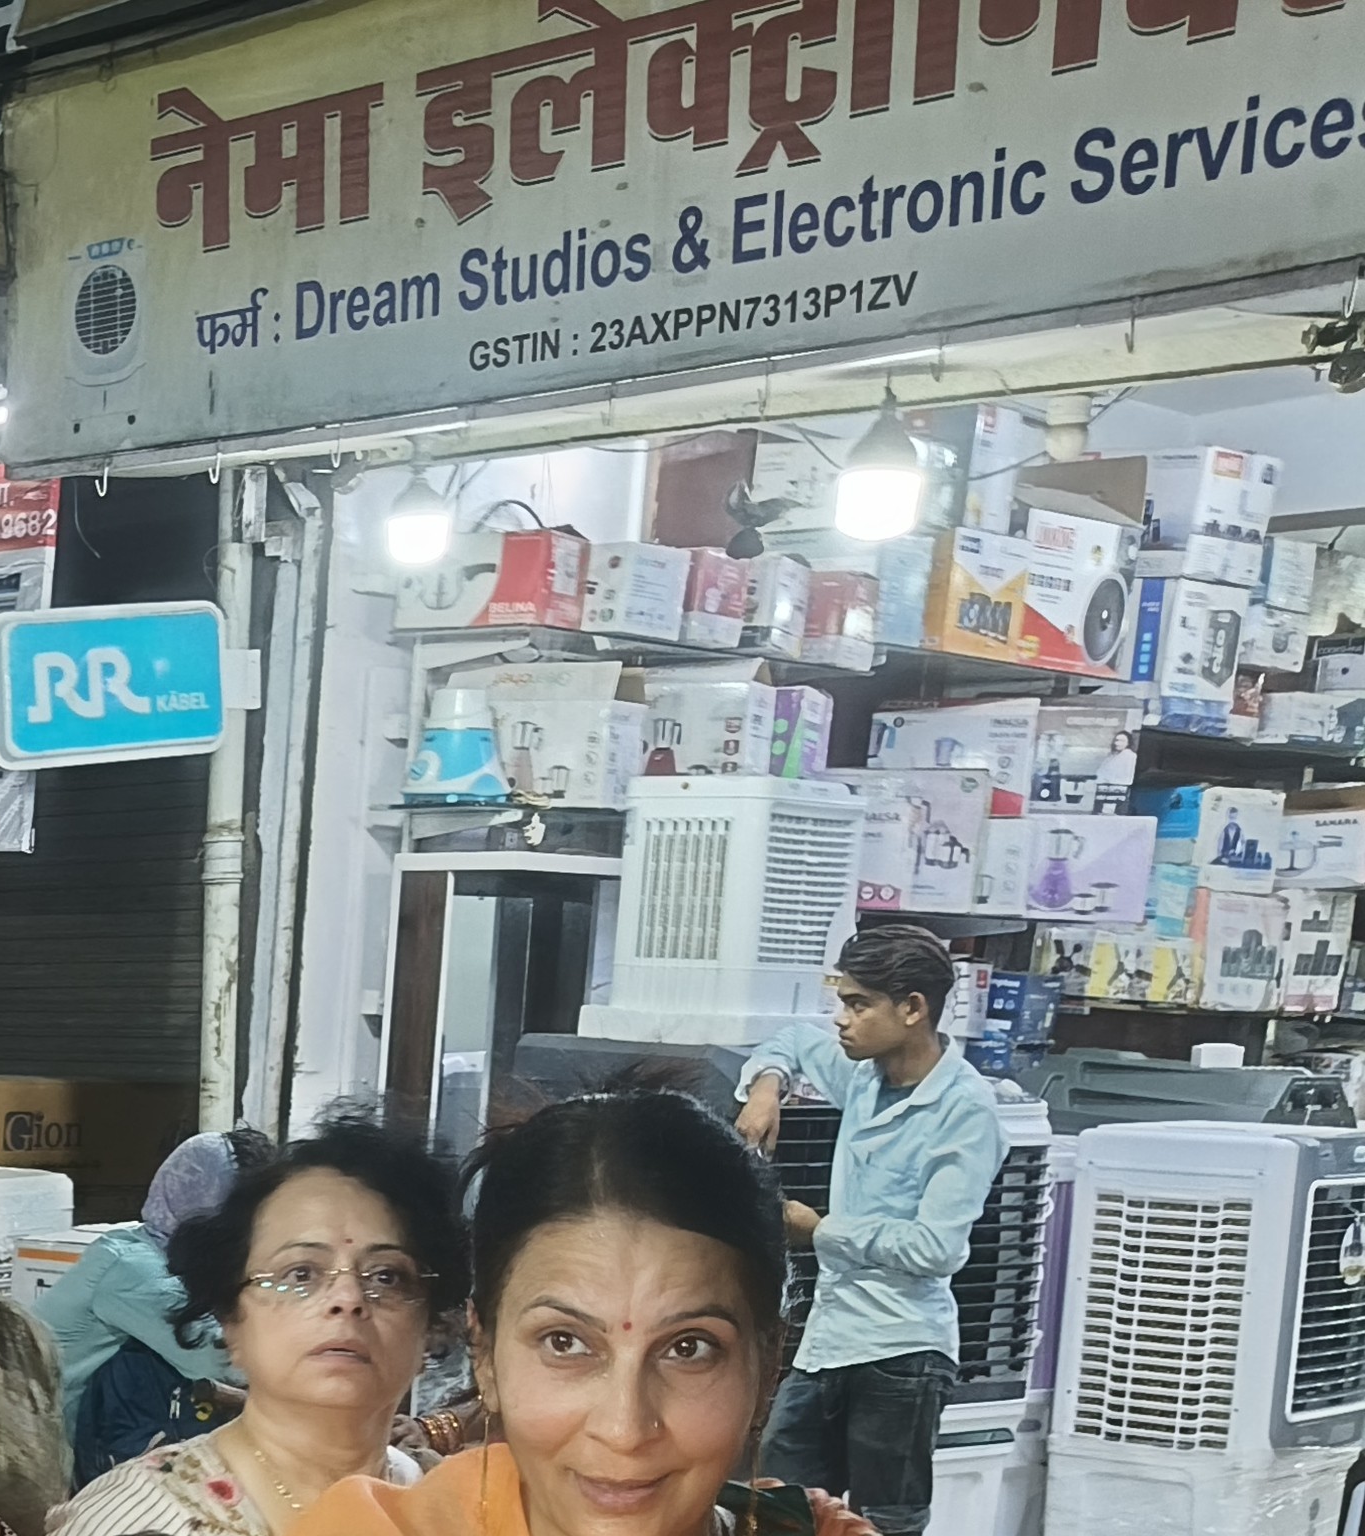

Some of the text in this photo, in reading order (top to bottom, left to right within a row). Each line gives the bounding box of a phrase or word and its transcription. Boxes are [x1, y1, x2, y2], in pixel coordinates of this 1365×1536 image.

[150, 83, 384, 253] नेमा
[196, 288, 269, 355] फर्म
[295, 271, 440, 341] Dream
[458, 228, 653, 310] Studios
[672, 206, 710, 274] &
[731, 147, 1046, 265] Electronic
[1070, 95, 1365, 204] Service
[469, 328, 560, 371] GSTIN
[589, 271, 918, 353] 23AXPPN7313P1ZV
[27, 646, 152, 723] RR
[4, 1111, 83, 1151] Gion
